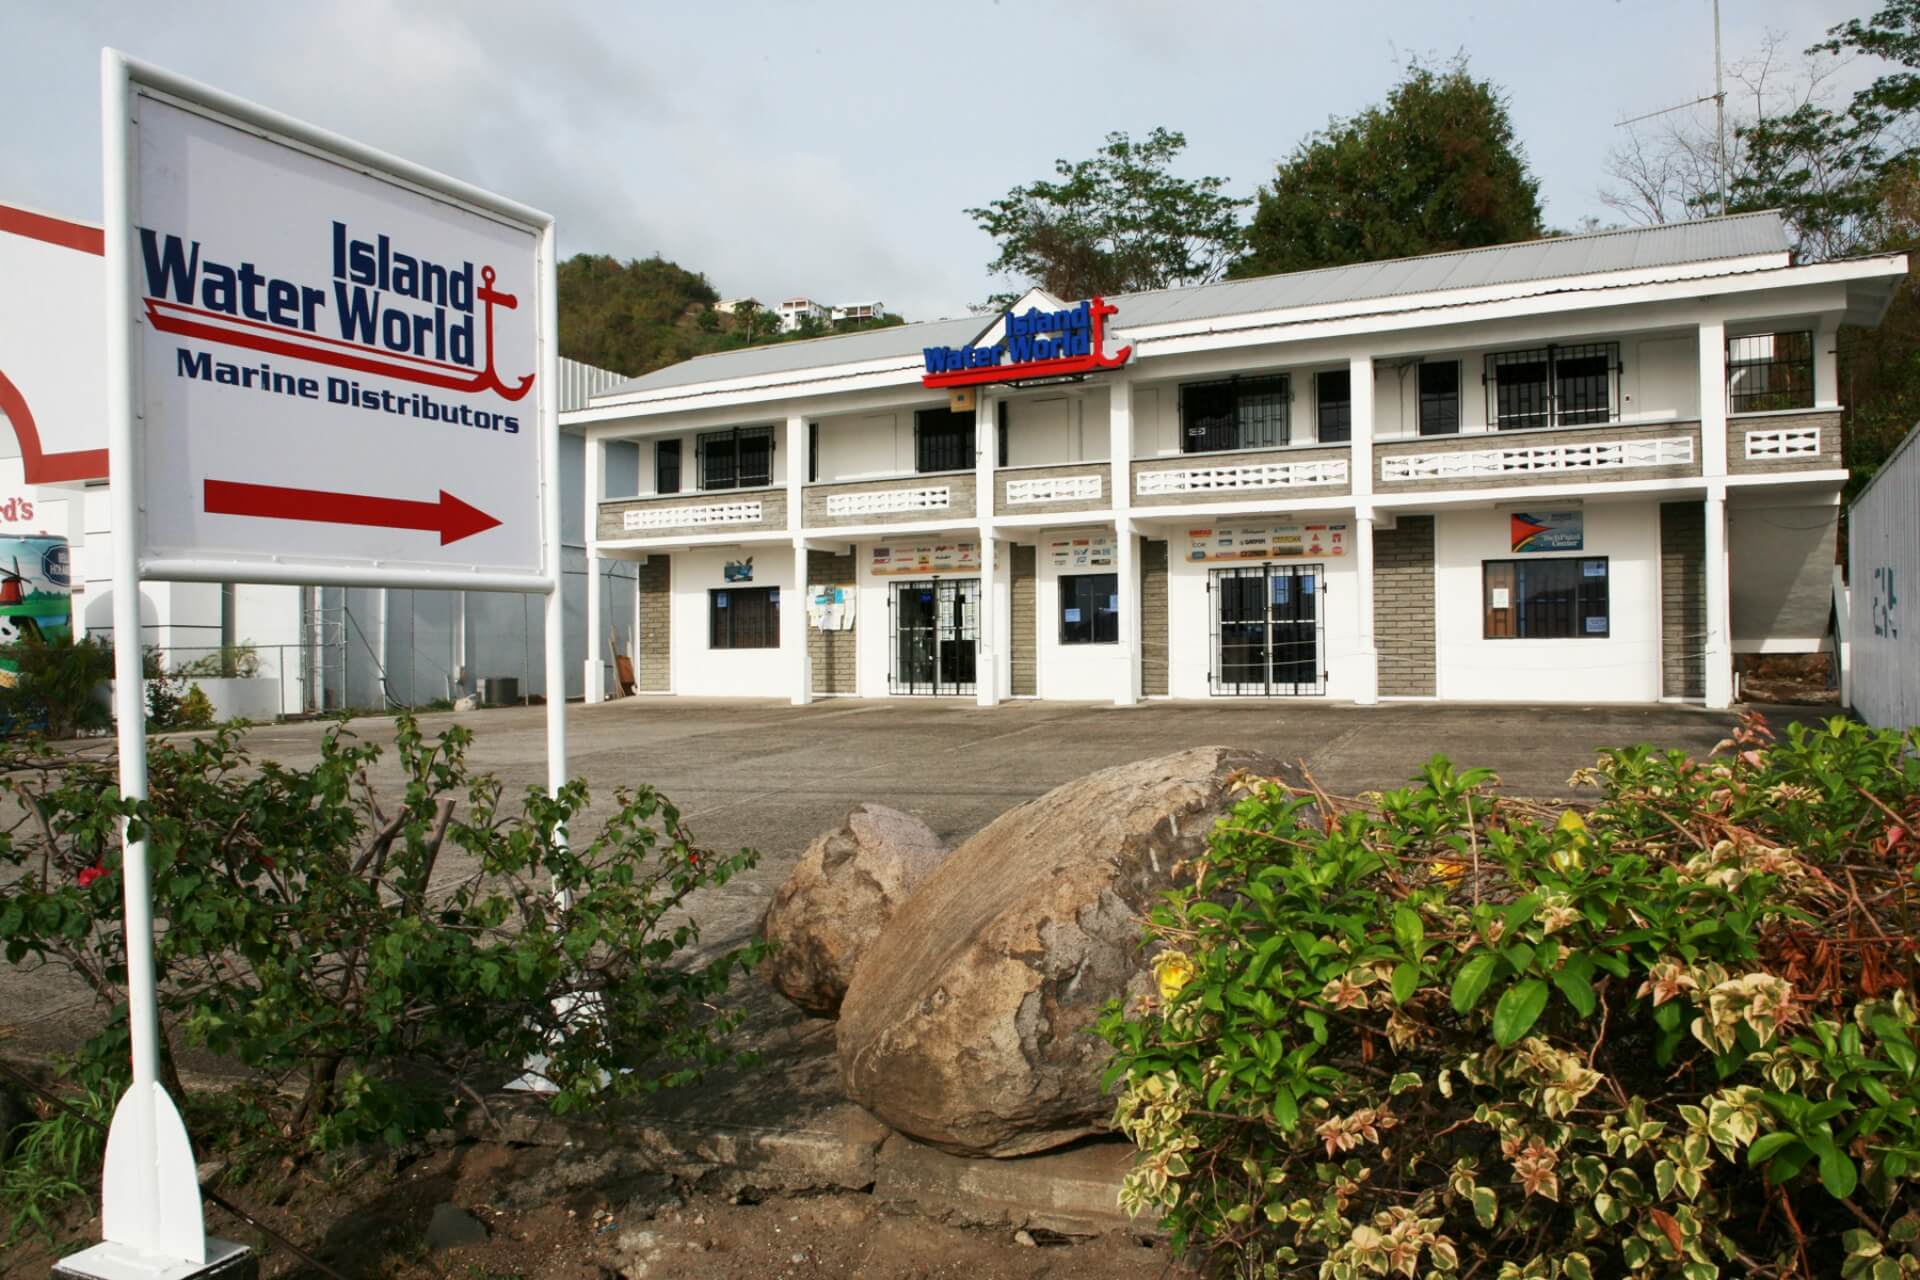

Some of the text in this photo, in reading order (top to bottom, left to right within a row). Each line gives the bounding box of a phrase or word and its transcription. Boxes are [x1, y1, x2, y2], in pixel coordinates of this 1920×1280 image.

[139, 227, 475, 366] Water World
[332, 220, 475, 314] Island
[923, 328, 1091, 373] Water World
[1005, 300, 1091, 337] Island
[177, 348, 519, 434] Marine Distributors
